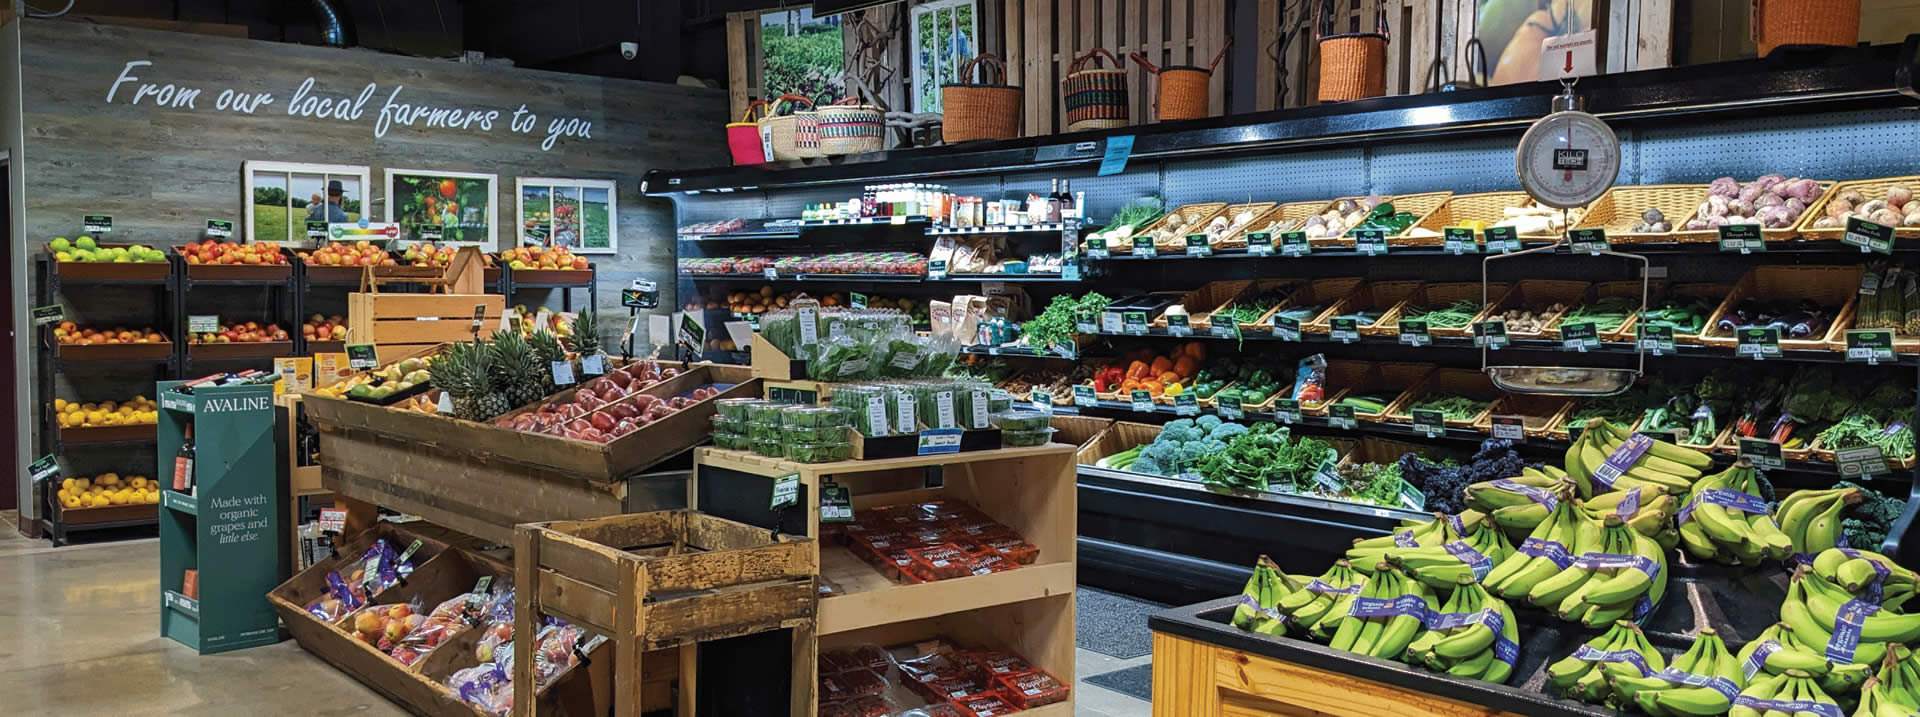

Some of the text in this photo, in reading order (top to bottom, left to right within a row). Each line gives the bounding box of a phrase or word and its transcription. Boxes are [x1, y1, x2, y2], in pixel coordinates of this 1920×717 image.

[106, 60, 592, 151] From our local farmers to you
[1558, 150, 1585, 158] KILO
[203, 396, 270, 413] AVALINE
[210, 496, 241, 509] Made
[243, 494, 267, 505] with
[219, 508, 259, 521] organic
[210, 517, 268, 535] grapes and
[219, 530, 259, 544] little else.
[924, 549, 961, 561] Poppies
[1017, 675, 1052, 690] Poppies
